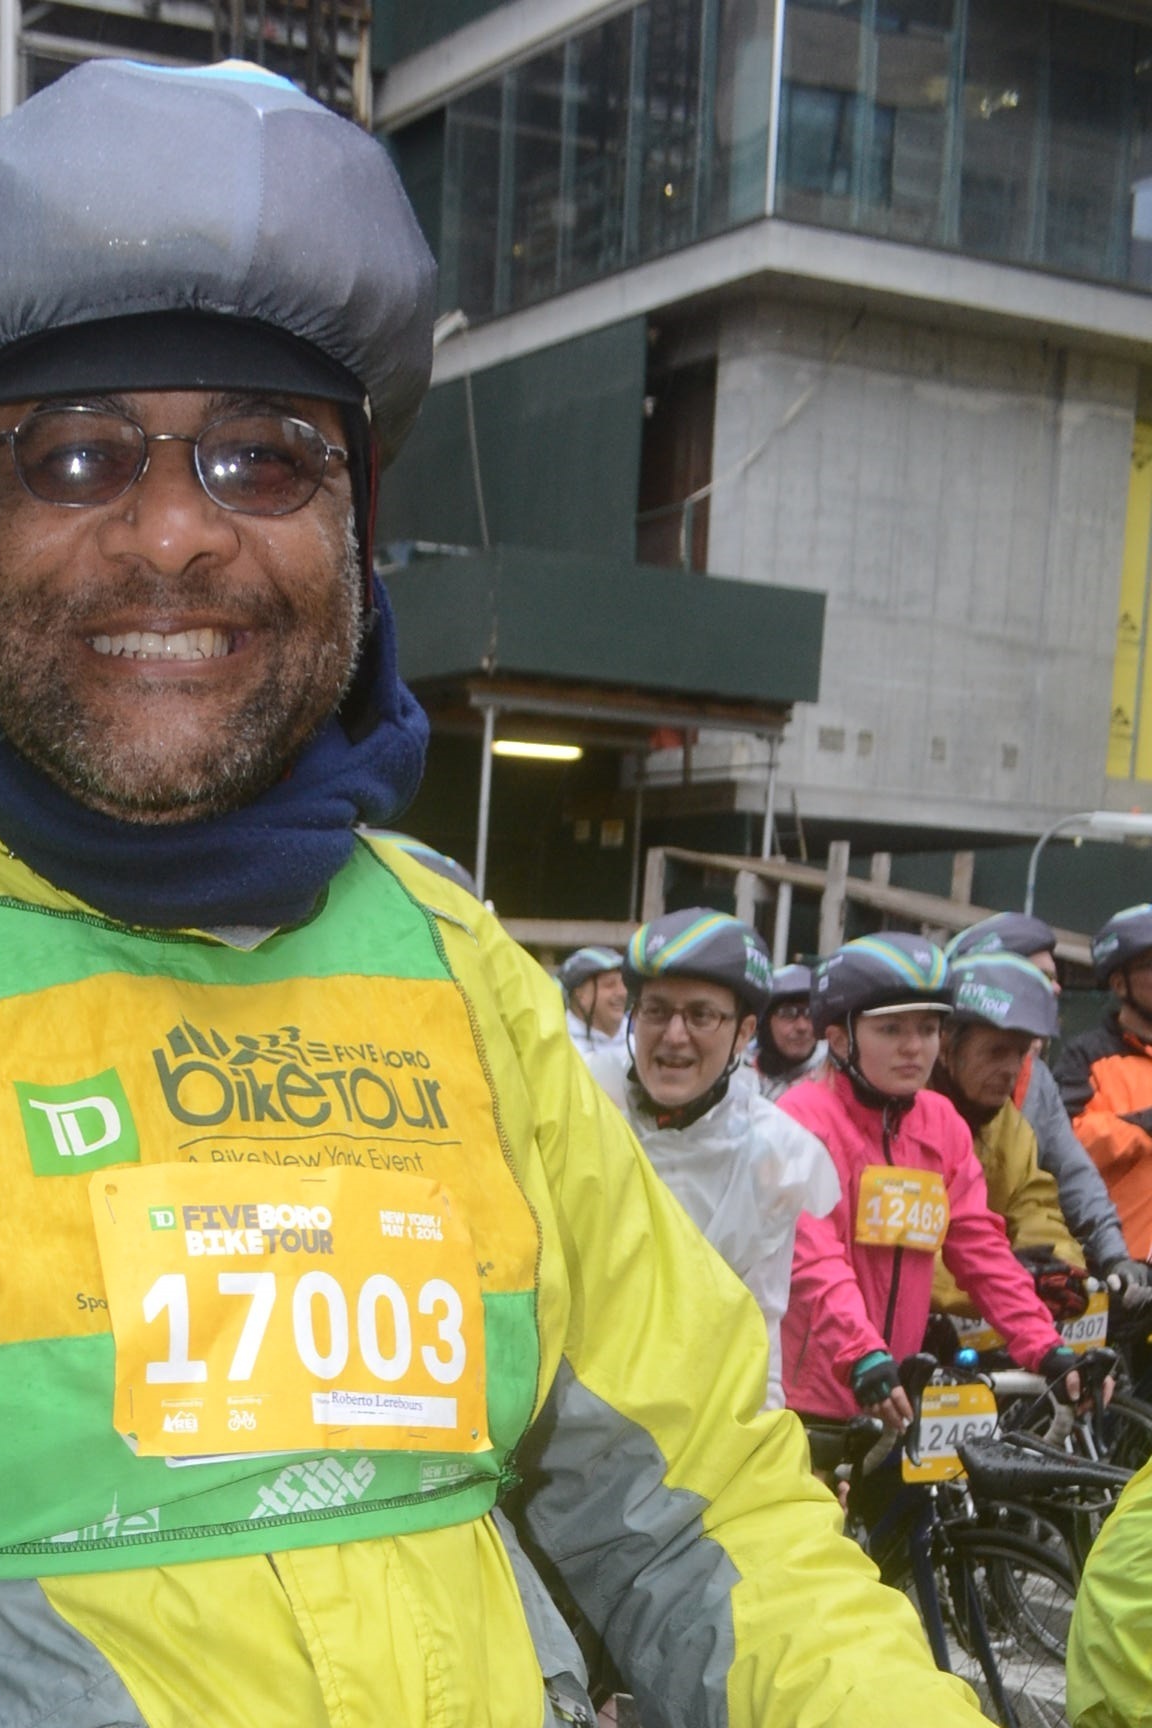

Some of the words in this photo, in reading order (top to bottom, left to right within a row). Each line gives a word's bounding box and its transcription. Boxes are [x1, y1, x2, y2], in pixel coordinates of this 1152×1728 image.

[333, 1043, 378, 1063] FIVE
[379, 1047, 431, 1069] ORO
[28, 1095, 121, 1156] TD
[324, 1145, 367, 1169] York
[368, 1148, 425, 1172] Event
[151, 1210, 175, 1228] TD
[379, 1209, 405, 1225] NEW
[866, 1195, 946, 1233] 12463
[382, 1223, 404, 1238] MAY
[416, 1226, 444, 1242] 2016
[77, 1292, 108, 1313] Spo
[143, 1271, 467, 1385] 17003
[1062, 1316, 1105, 1340] 4307
[332, 1391, 374, 1408] Roberto
[376, 1394, 424, 1412] Lerebours
